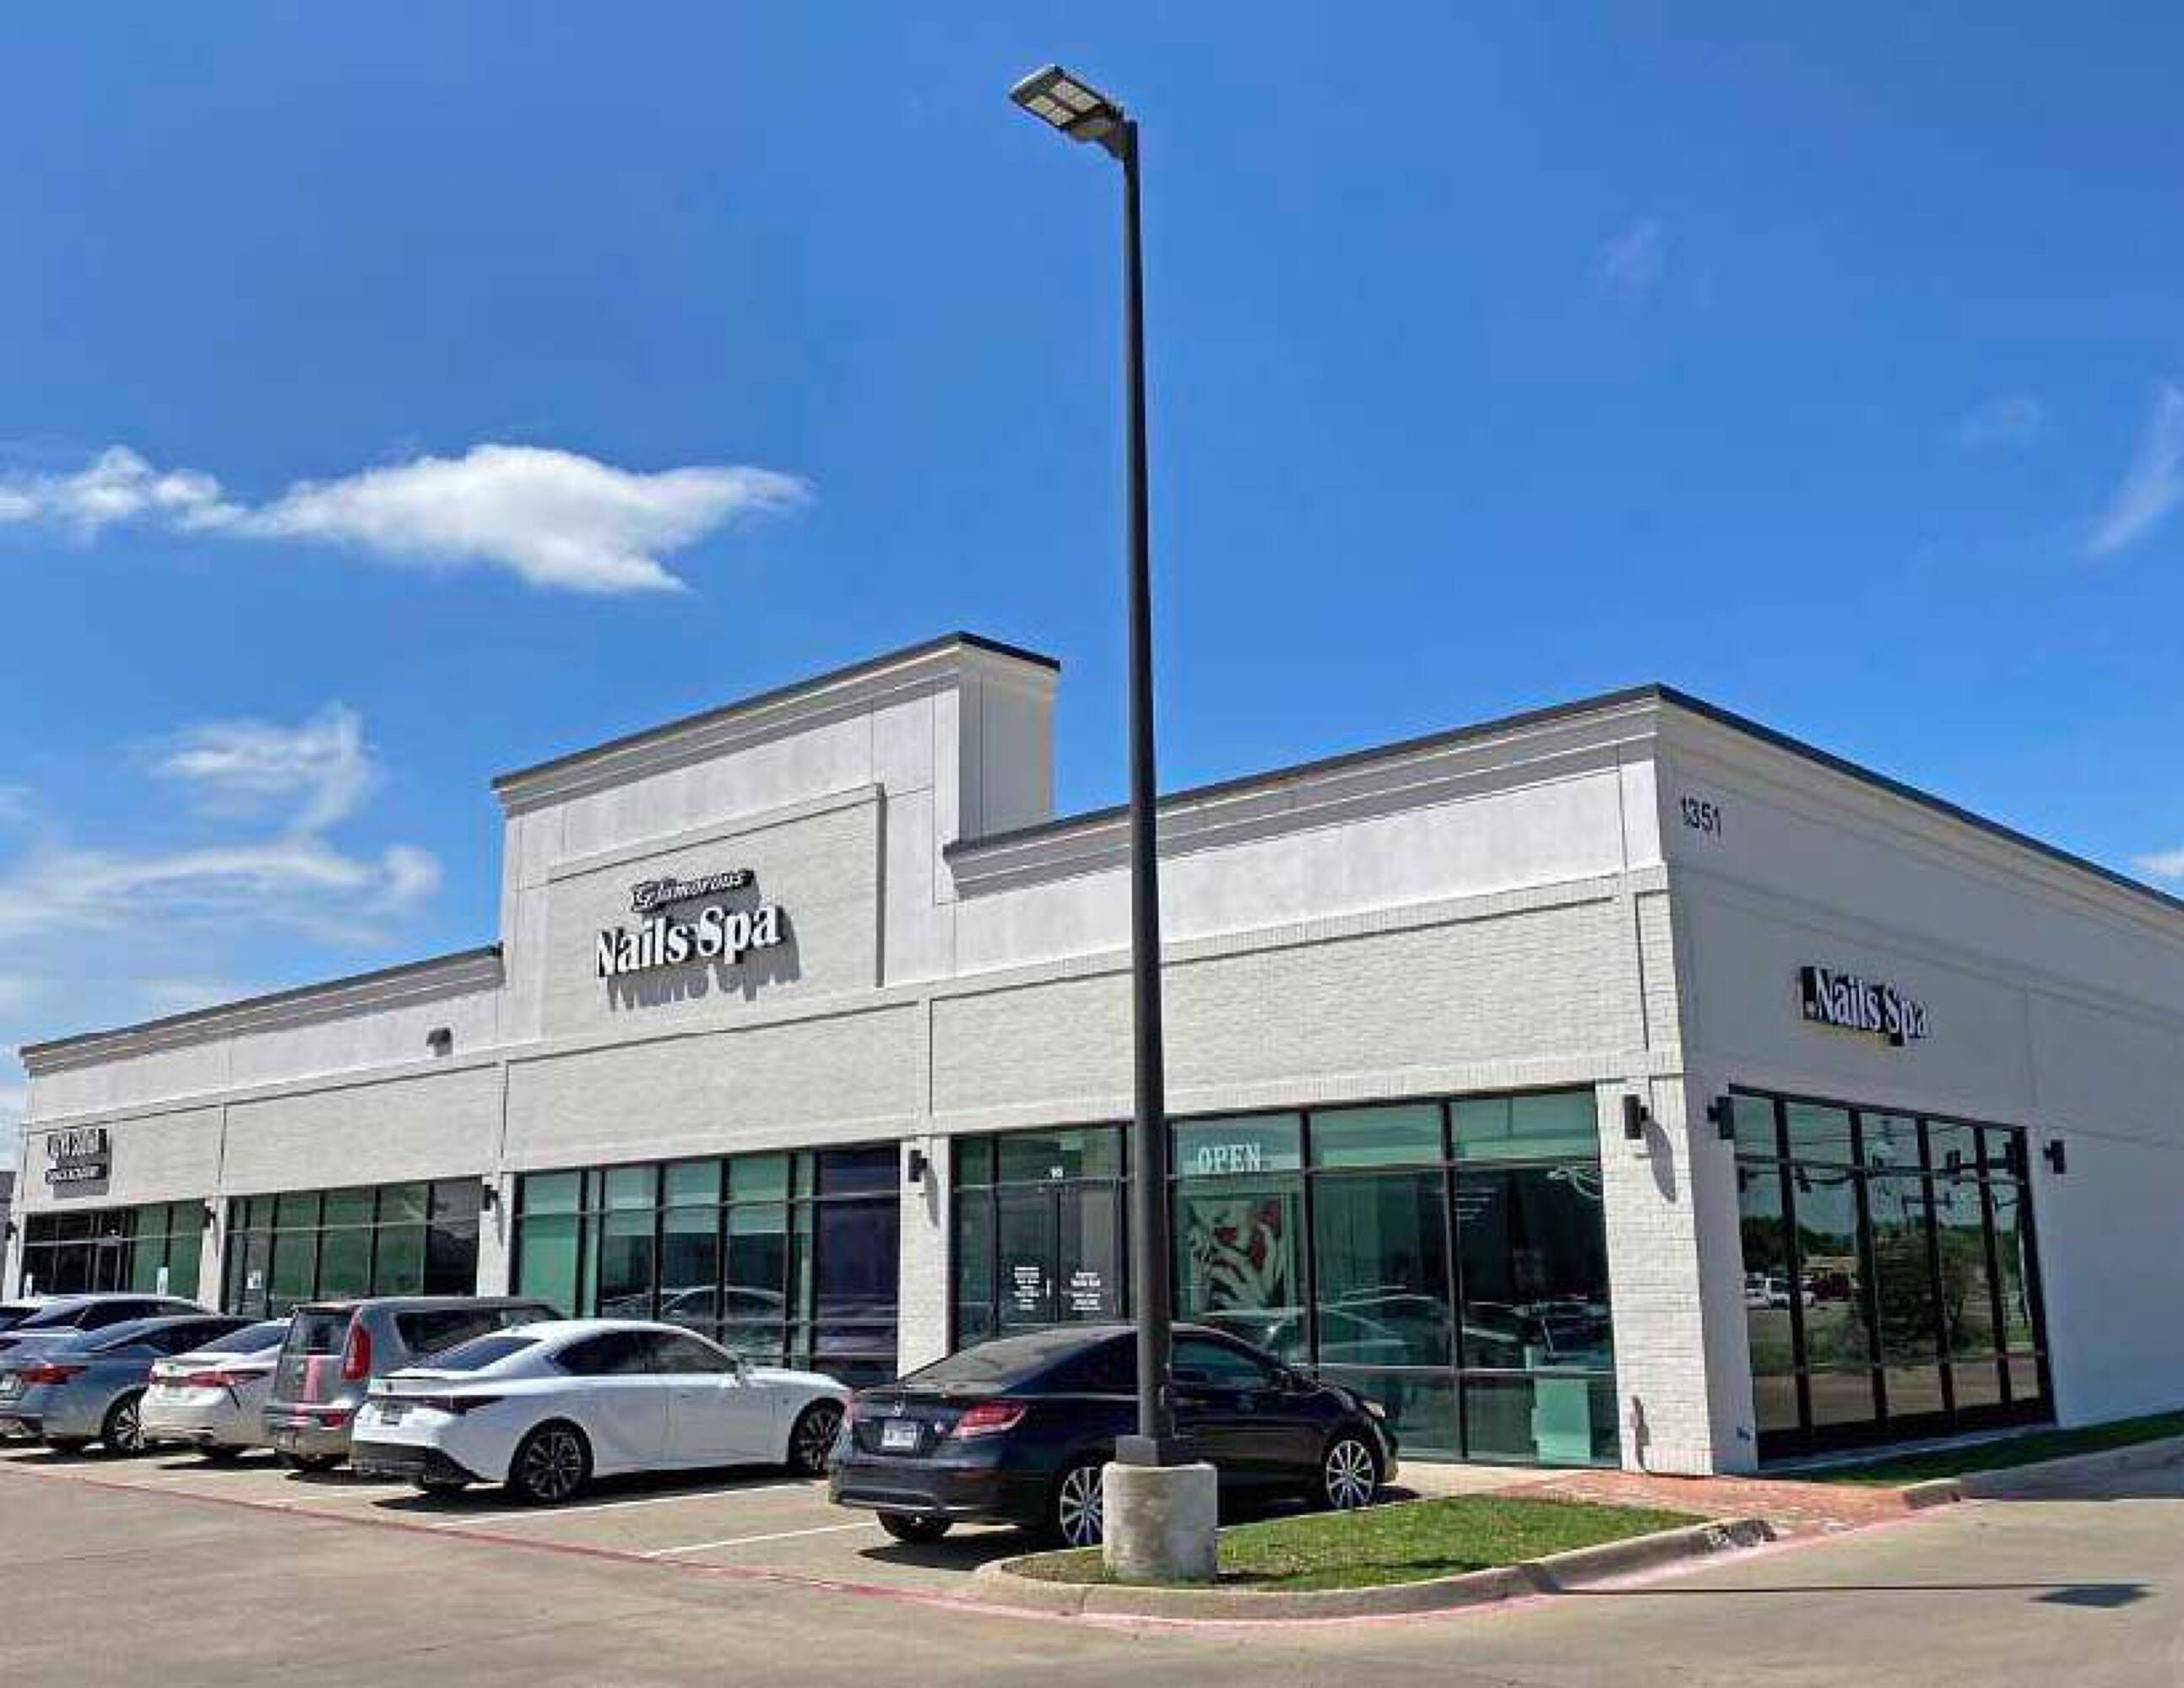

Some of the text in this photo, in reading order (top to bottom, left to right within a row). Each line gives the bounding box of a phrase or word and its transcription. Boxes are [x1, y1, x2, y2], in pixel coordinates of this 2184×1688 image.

[1680, 795, 1721, 836] 1351
[595, 904, 783, 977] Nails Spa
[1814, 967, 1931, 1045] Nails Spa
[1198, 1143, 1260, 1172] OPEN
